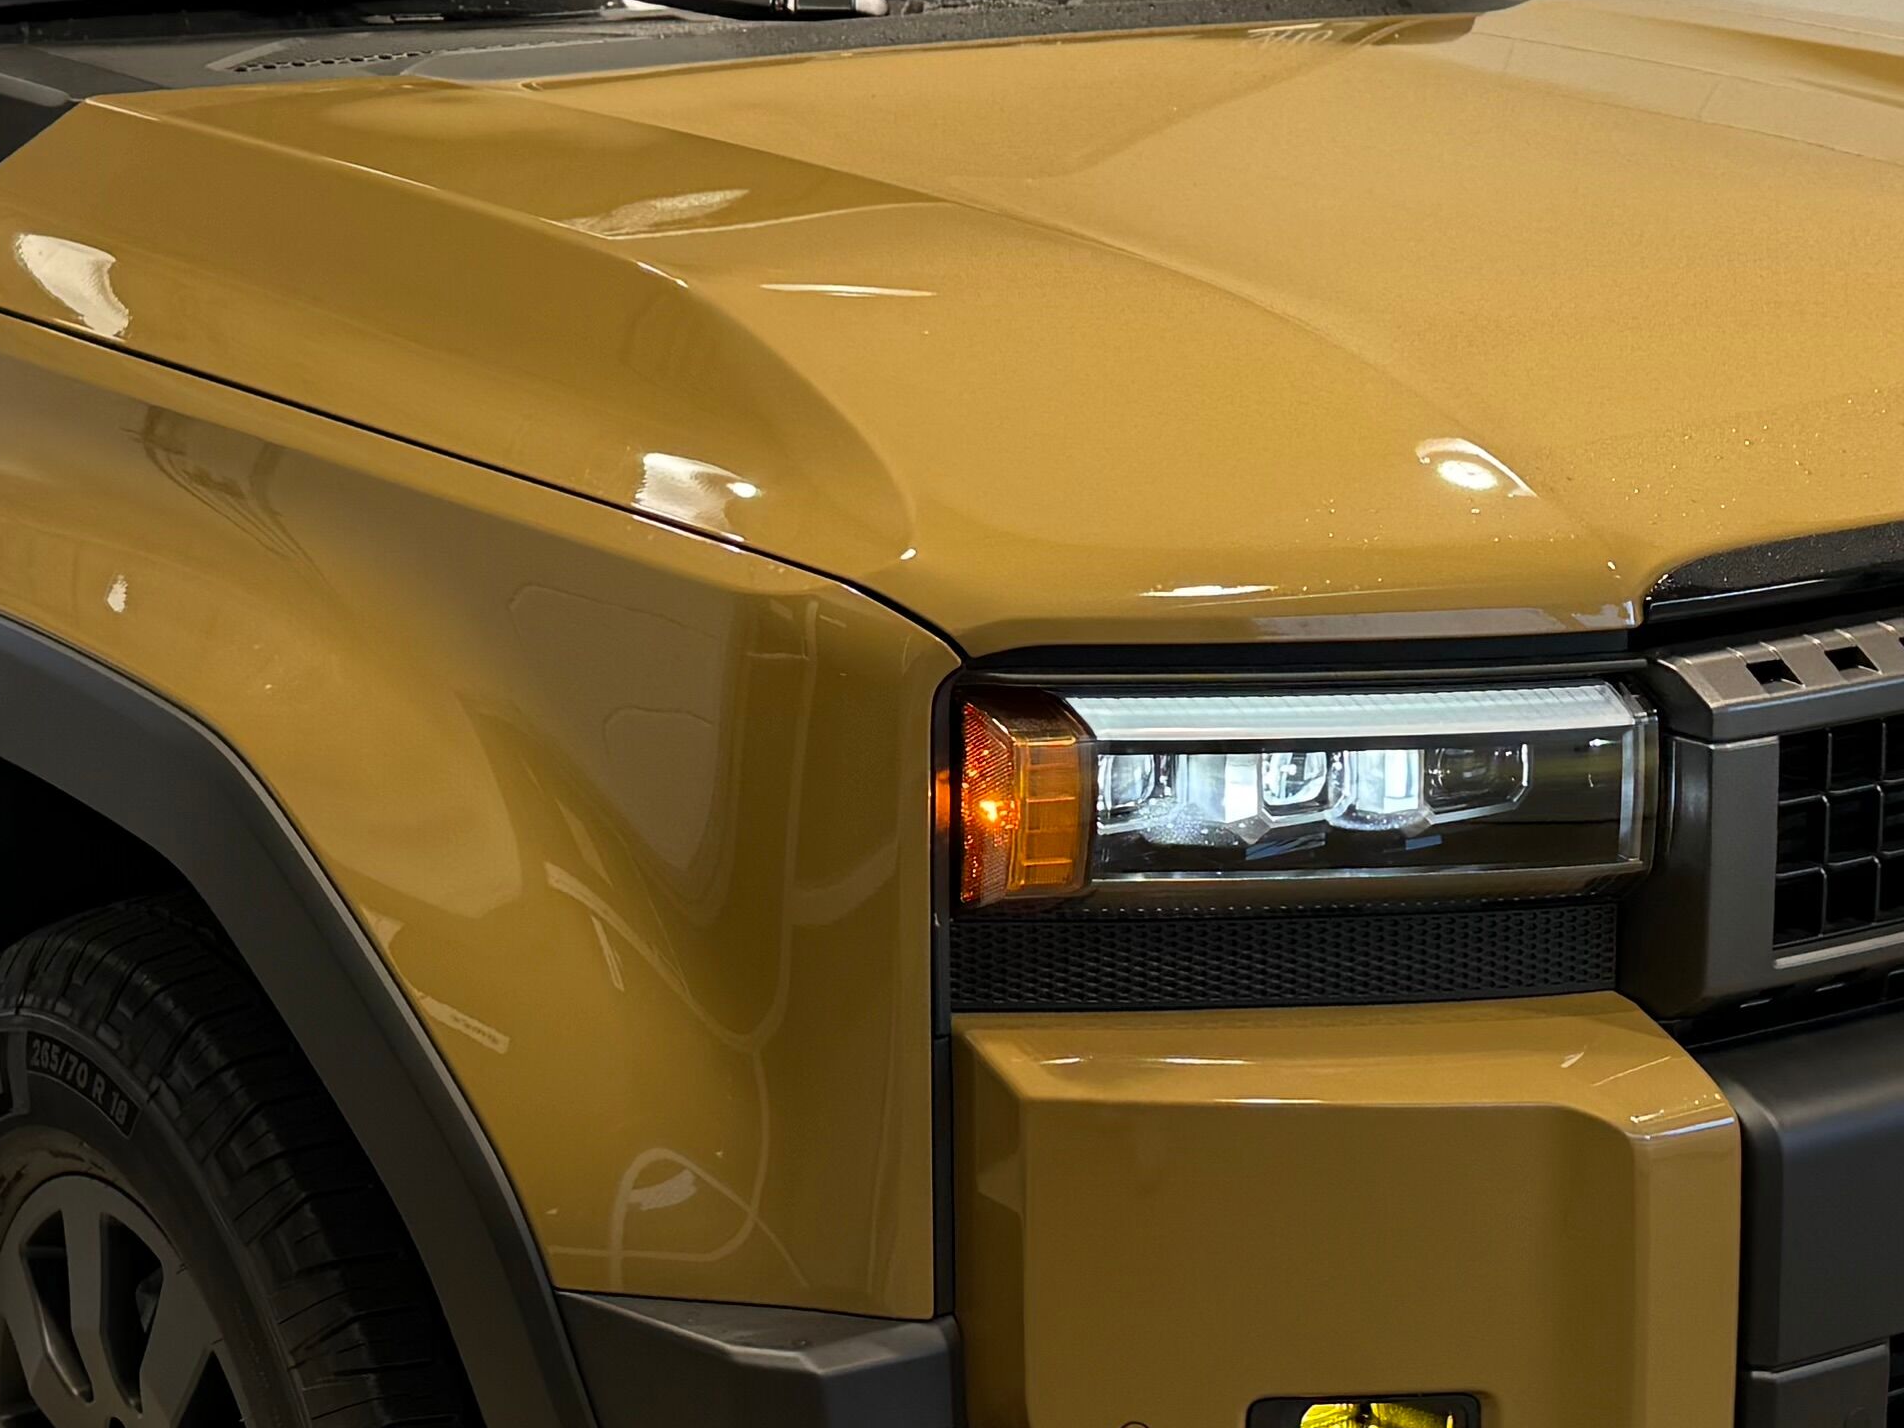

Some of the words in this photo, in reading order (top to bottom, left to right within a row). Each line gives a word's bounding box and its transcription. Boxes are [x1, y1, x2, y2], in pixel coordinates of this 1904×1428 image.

[30, 1037, 90, 1092] 265/70
[91, 1074, 106, 1105] R
[111, 1092, 130, 1125] 18
